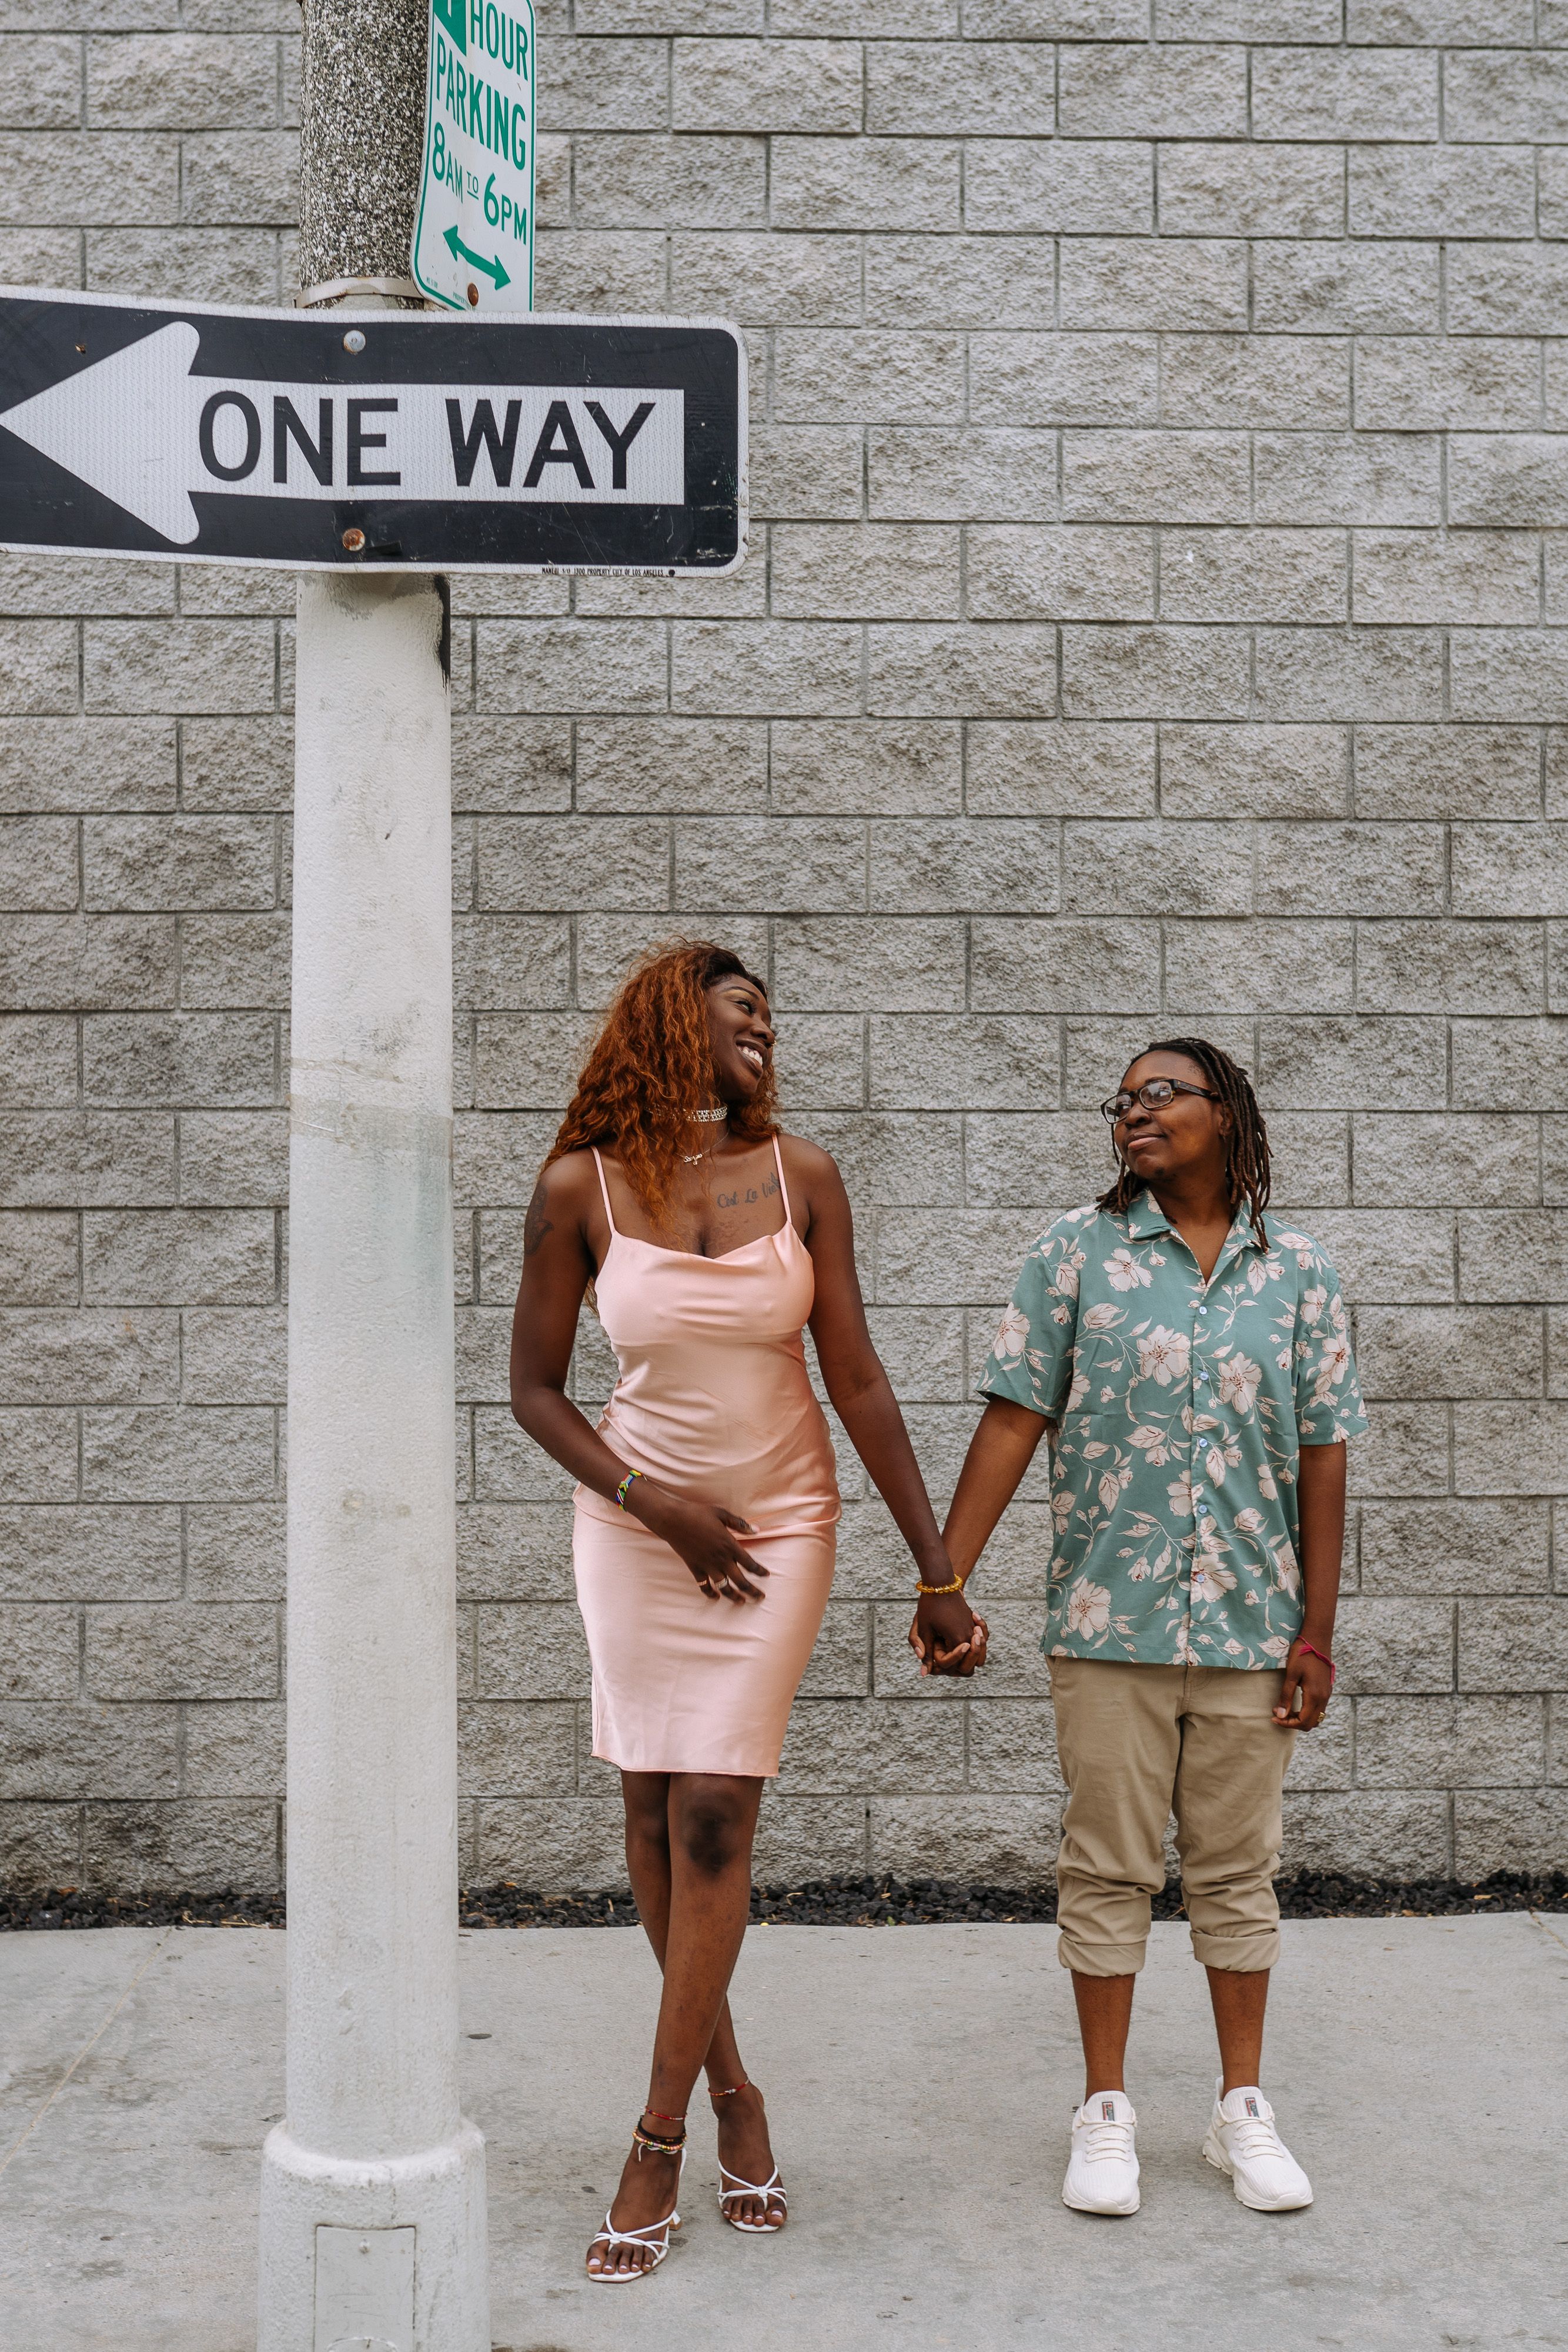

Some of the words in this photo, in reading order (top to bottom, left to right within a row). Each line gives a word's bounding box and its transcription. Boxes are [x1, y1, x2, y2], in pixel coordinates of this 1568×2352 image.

[471, 0, 528, 82] HOUR
[436, 32, 526, 171] PARKING
[432, 122, 463, 203] 8AM
[466, 172, 479, 194] TO
[484, 173, 527, 245] 6PM
[199, 390, 401, 486] ONE
[445, 398, 656, 489] WAY
